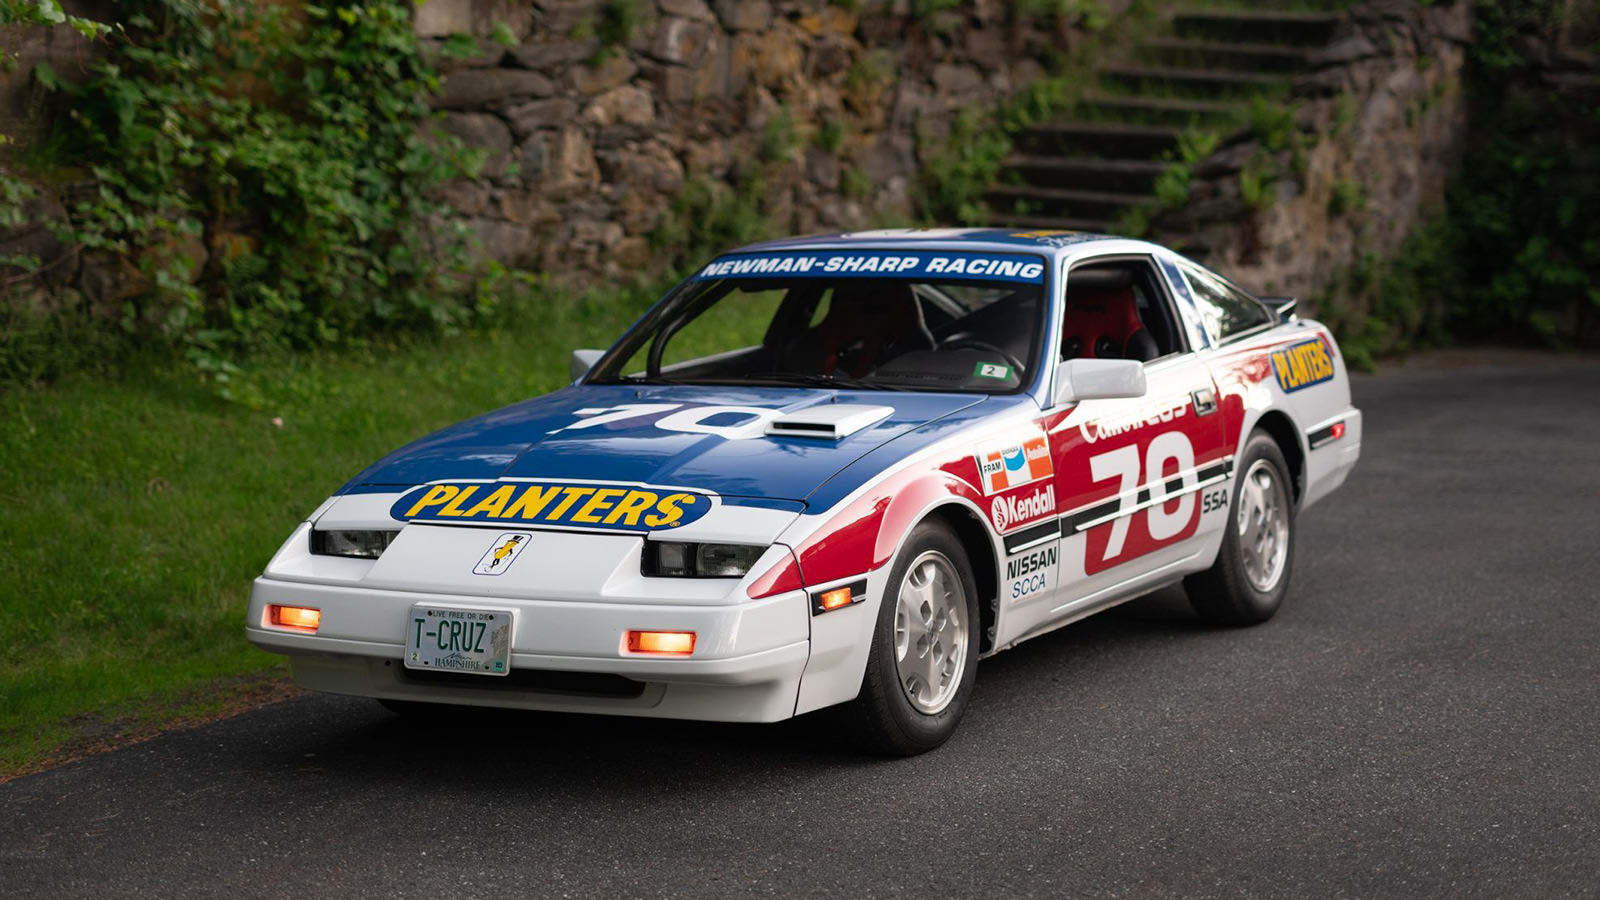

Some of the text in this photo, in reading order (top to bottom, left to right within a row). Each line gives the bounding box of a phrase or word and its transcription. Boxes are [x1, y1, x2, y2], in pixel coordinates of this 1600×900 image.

[701, 256, 1044, 279] NEWMAN-SHARP RACING
[987, 366, 996, 375] 2
[1271, 339, 1334, 390] PLANTERS
[546, 403, 787, 439] 70
[983, 460, 1002, 474] FRAM
[403, 484, 697, 528] PLANTERS
[1007, 484, 1056, 525] Kendall
[1089, 430, 1195, 561] 70
[1203, 489, 1228, 513] SSA
[1006, 546, 1057, 581] NISSAN
[1012, 572, 1046, 599] SCCA
[432, 610, 489, 621] LIVE FREE OR DIE
[415, 618, 486, 653] T-CRUZ
[434, 658, 480, 670] HAMPSHIRE
